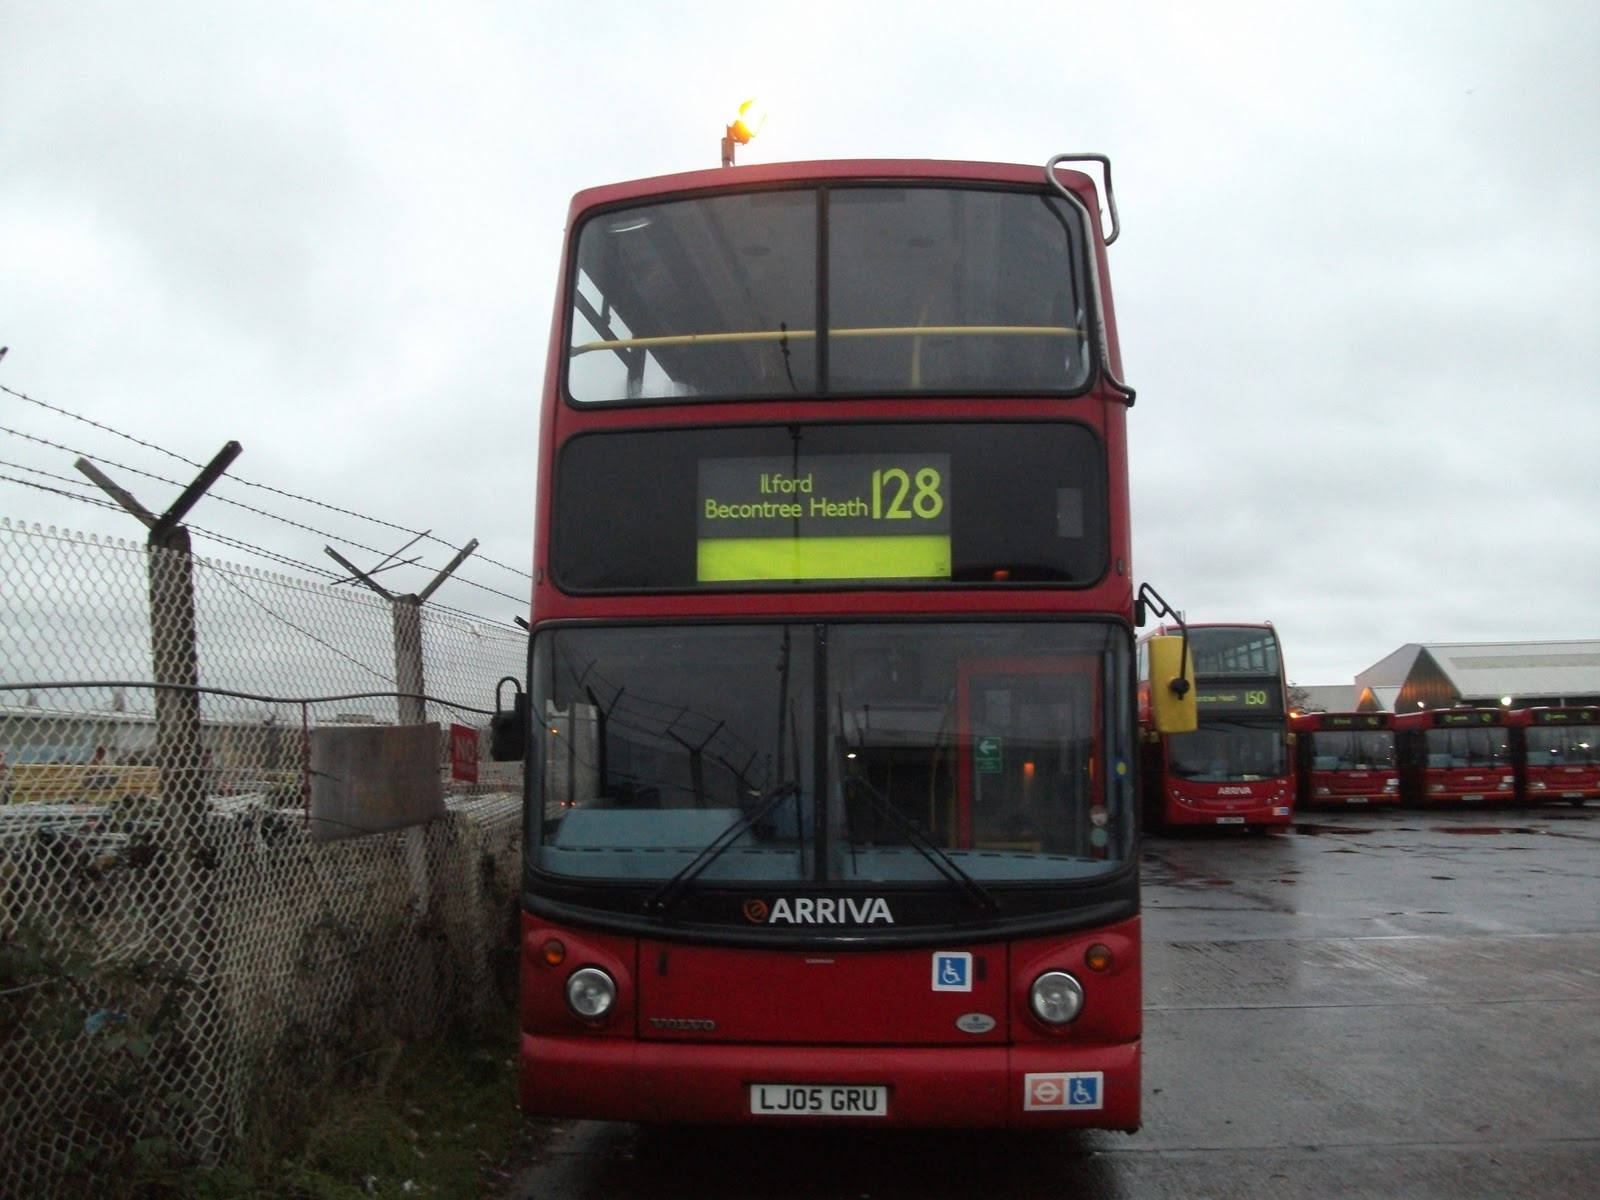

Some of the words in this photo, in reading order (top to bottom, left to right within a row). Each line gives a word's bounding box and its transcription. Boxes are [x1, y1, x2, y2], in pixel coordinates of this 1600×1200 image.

[760, 473, 813, 493] Ilford
[872, 467, 943, 519] 128
[705, 499, 802, 518] Becontree
[810, 497, 868, 517] Heath
[1245, 691, 1266, 704] 150
[769, 898, 894, 924] ARRIVA
[650, 1018, 715, 1031] VOLVO
[761, 1088, 822, 1110] LJ05
[831, 1089, 877, 1111] GRU
